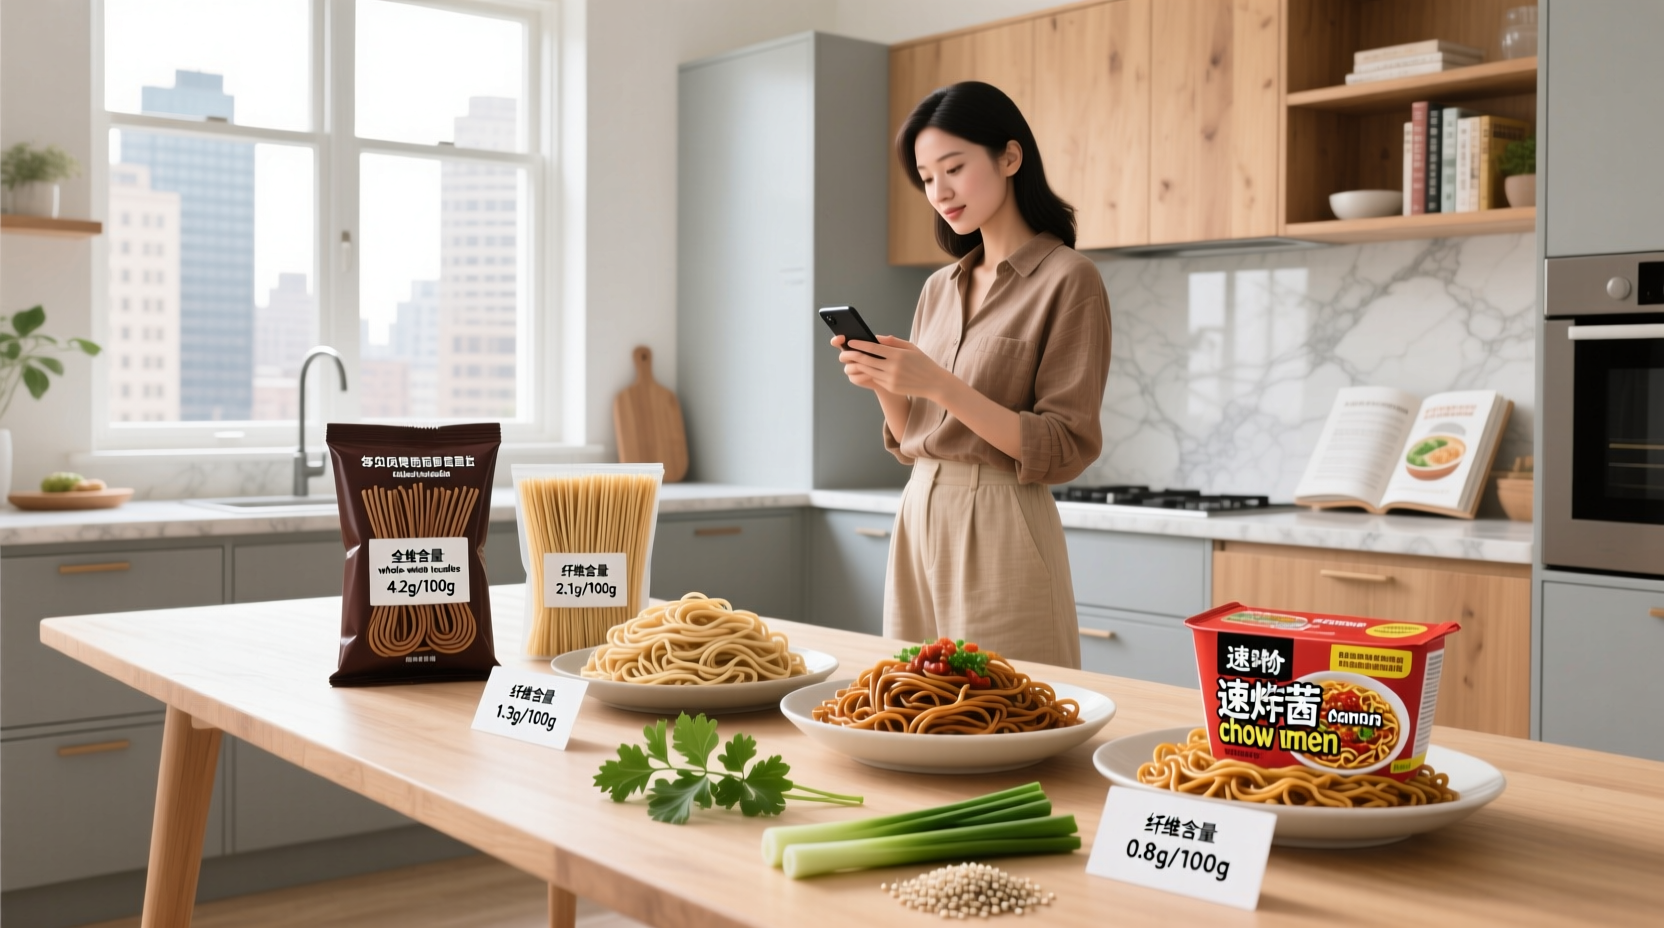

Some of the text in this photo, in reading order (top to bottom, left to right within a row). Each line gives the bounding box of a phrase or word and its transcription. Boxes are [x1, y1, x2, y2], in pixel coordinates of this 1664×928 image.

[387, 579, 455, 597] 4.2g/100g
[556, 582, 617, 598] 2.1g/100g
[497, 704, 557, 732] 1.3g/100g
[1219, 717, 1274, 748] chow
[1144, 812, 1218, 844] 纤维含量
[1126, 838, 1230, 882] 0.8g/100g
